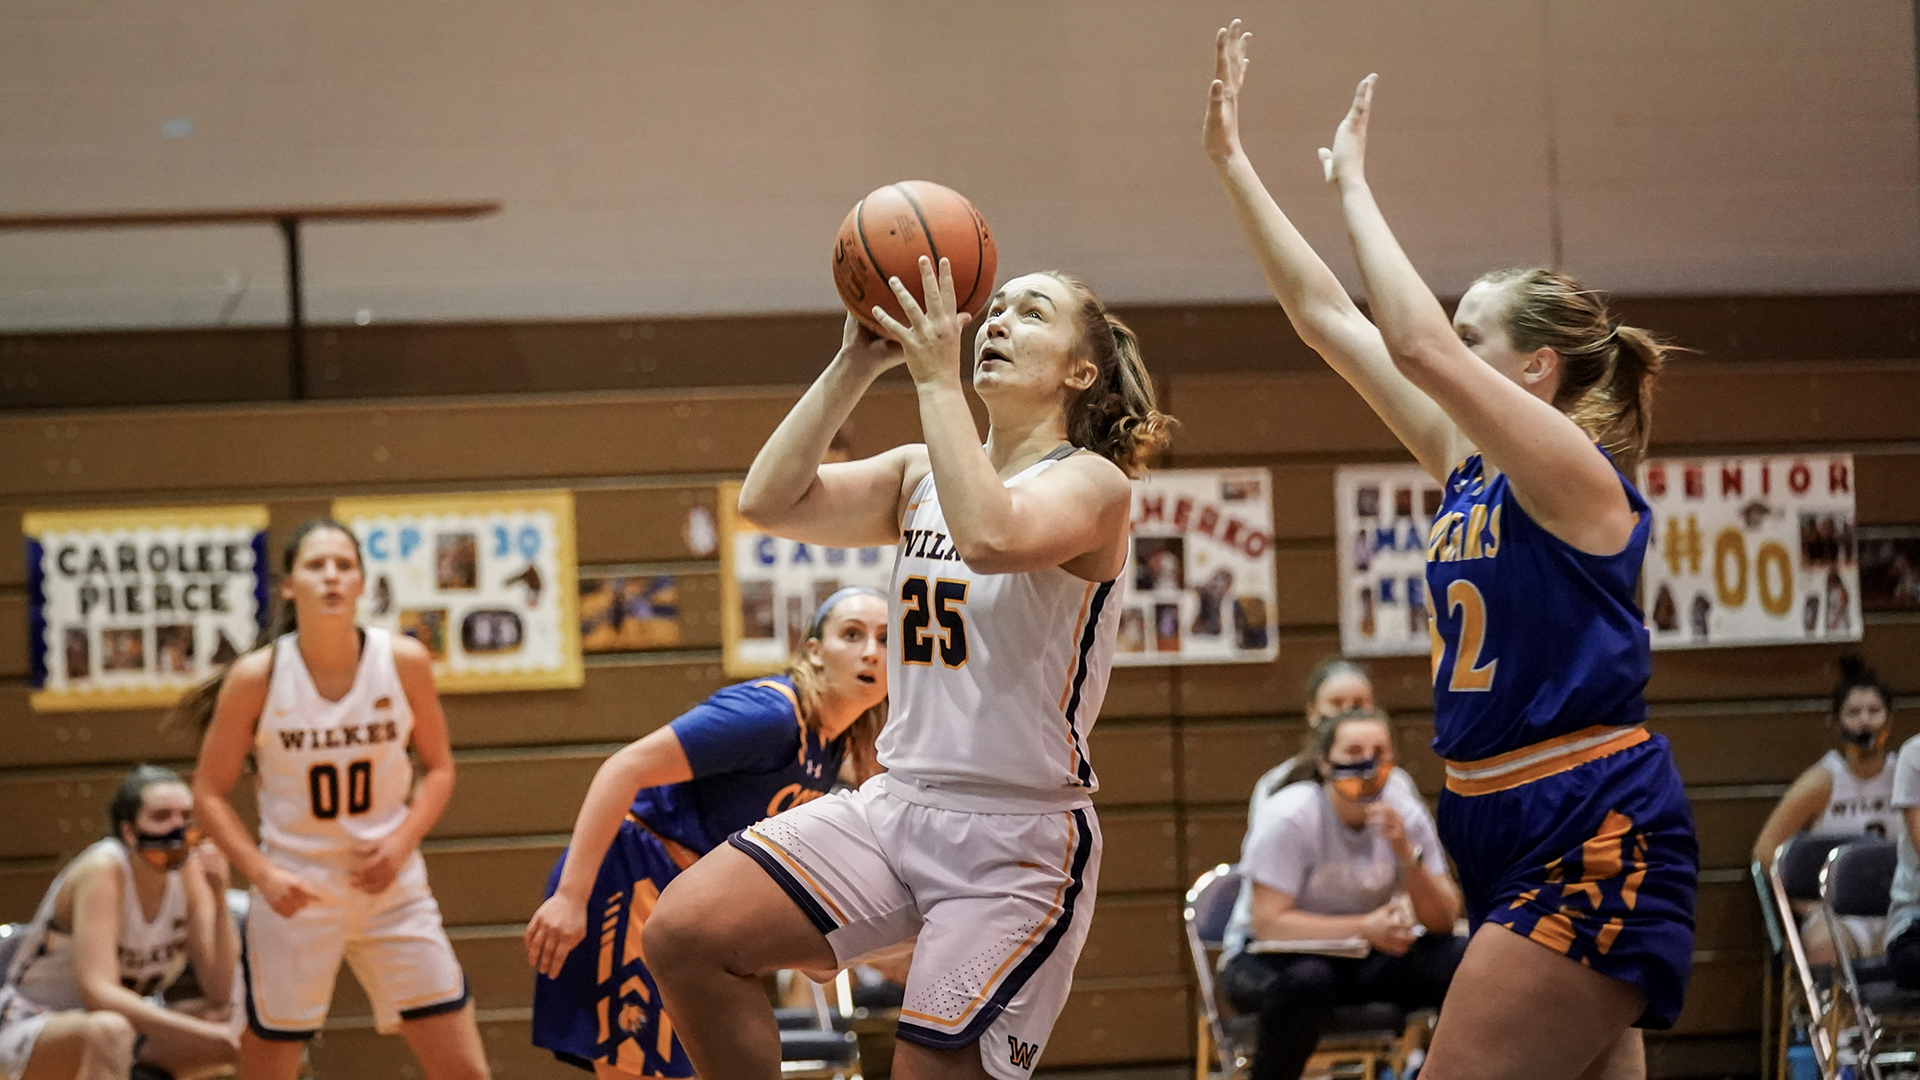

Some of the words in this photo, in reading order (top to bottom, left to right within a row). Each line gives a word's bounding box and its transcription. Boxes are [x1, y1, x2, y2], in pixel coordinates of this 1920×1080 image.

[1647, 463, 1849, 497] SENIOR
[367, 527, 421, 561] CP
[493, 524, 542, 559] 30
[1130, 497, 1269, 559] HERKO
[57, 543, 246, 576] CAROLEE
[78, 582, 230, 616] PIERCE
[901, 574, 971, 670] 25
[277, 720, 399, 750] WILKES
[308, 759, 373, 819] 00
[1007, 1034, 1039, 1071] W
